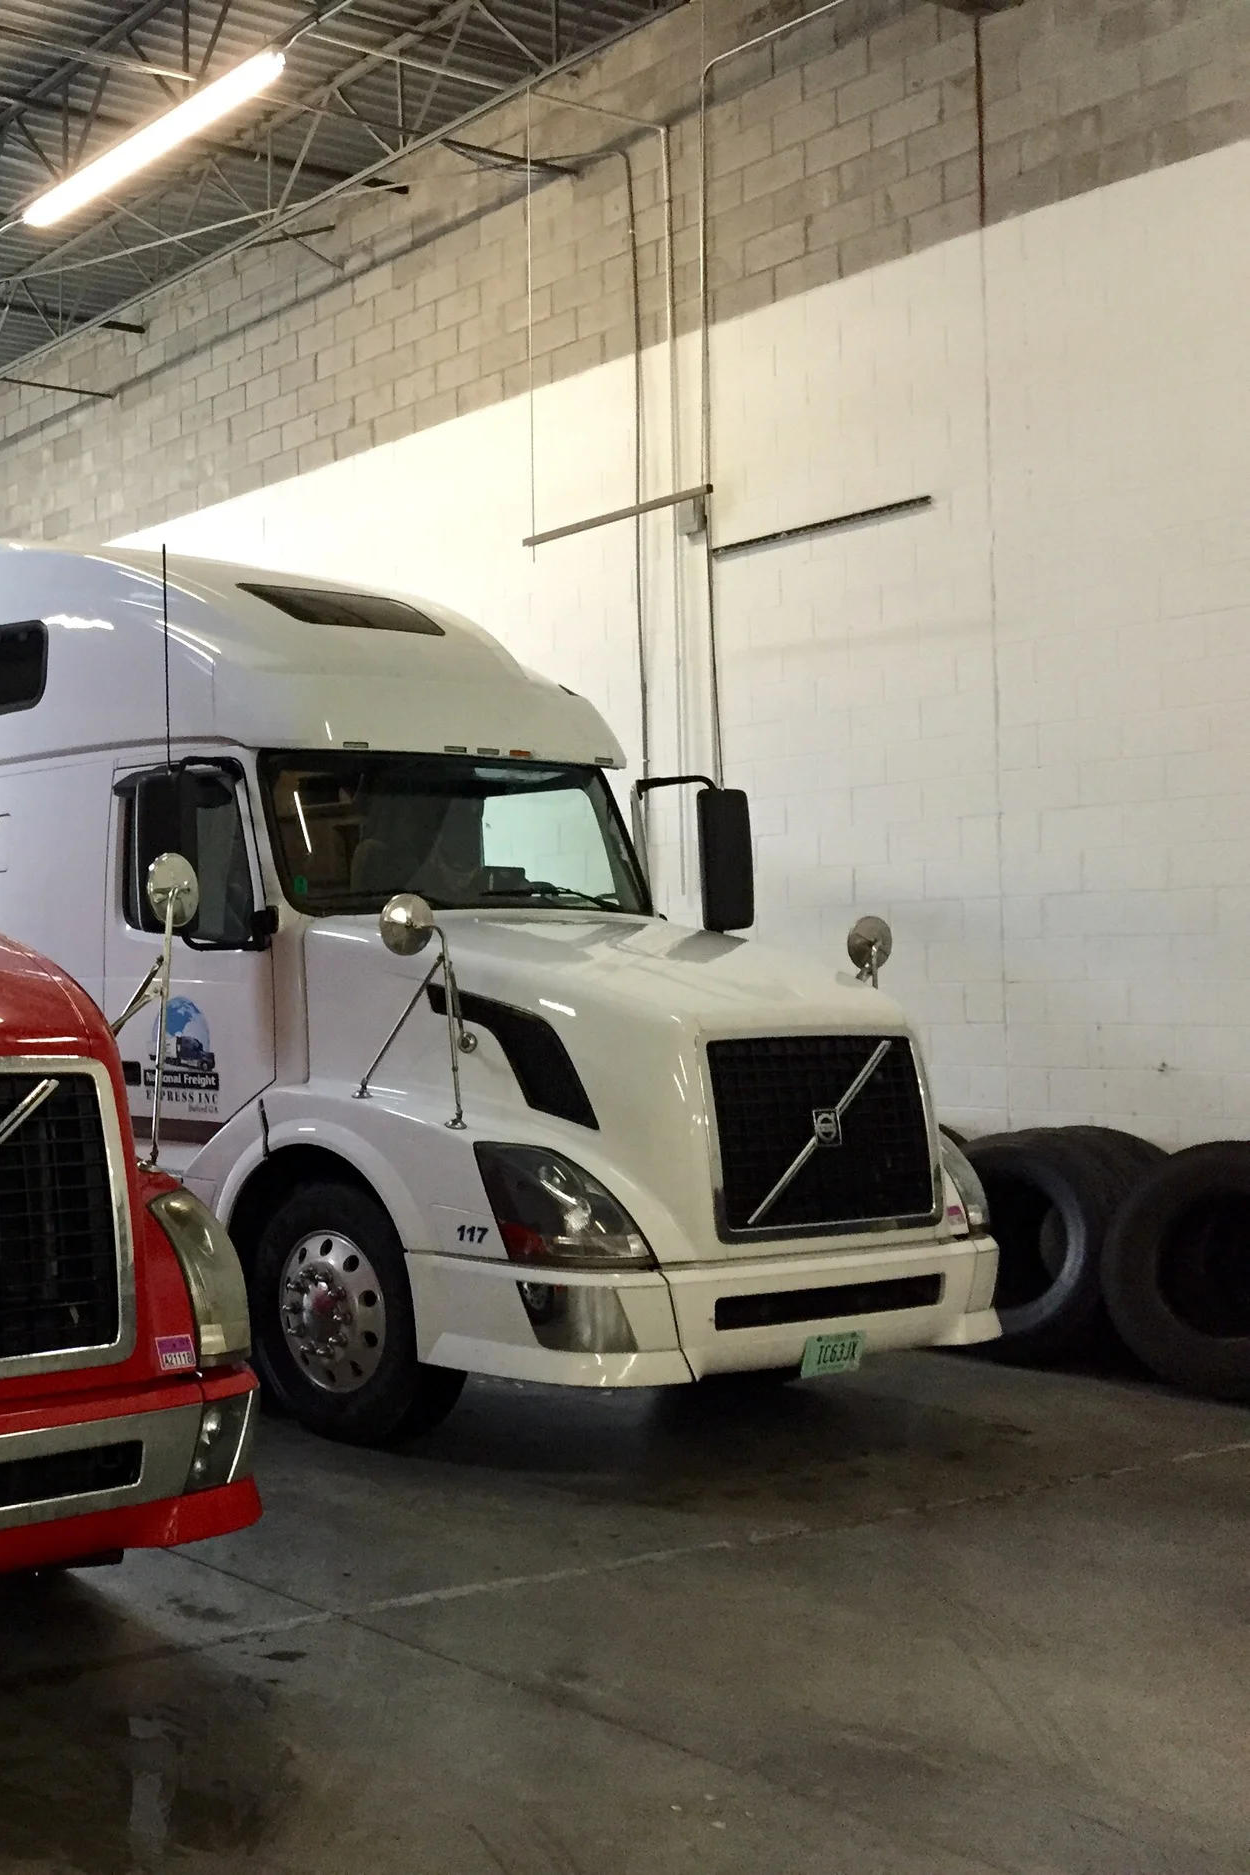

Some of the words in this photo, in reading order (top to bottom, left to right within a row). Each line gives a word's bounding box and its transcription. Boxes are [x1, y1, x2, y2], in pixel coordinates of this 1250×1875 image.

[146, 1071, 181, 1084] Naonal
[184, 1073, 216, 1087] Freight
[198, 1092, 218, 1104] INC
[456, 1224, 489, 1244] 117
